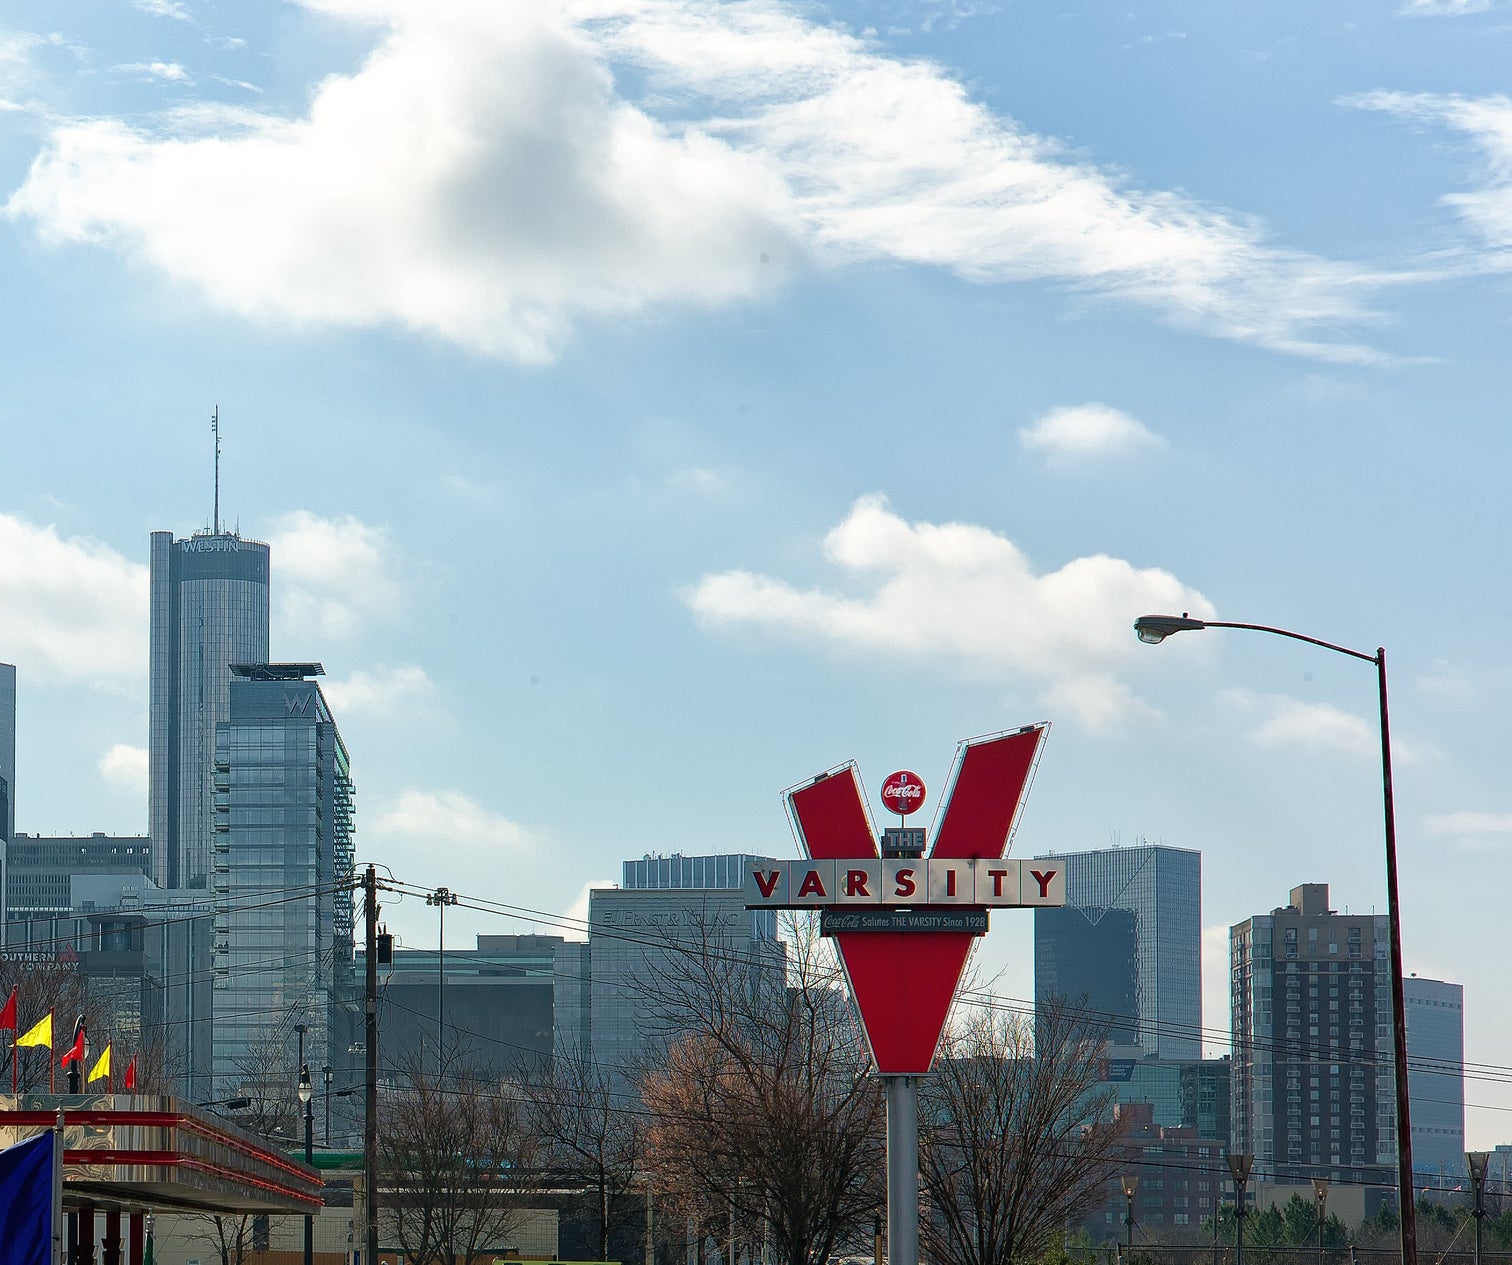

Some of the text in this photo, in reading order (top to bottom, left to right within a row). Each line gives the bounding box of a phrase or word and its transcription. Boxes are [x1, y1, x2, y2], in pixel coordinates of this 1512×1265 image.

[182, 540, 239, 553] WESTIN
[888, 832, 924, 847] THE
[752, 869, 1058, 898] VARSITY
[862, 916, 890, 927] Salutes
[891, 917, 907, 927] THE
[908, 917, 942, 927] VARSITY
[943, 916, 963, 927] Since
[965, 917, 986, 927] 1928
[19, 962, 80, 971] COMPANY
